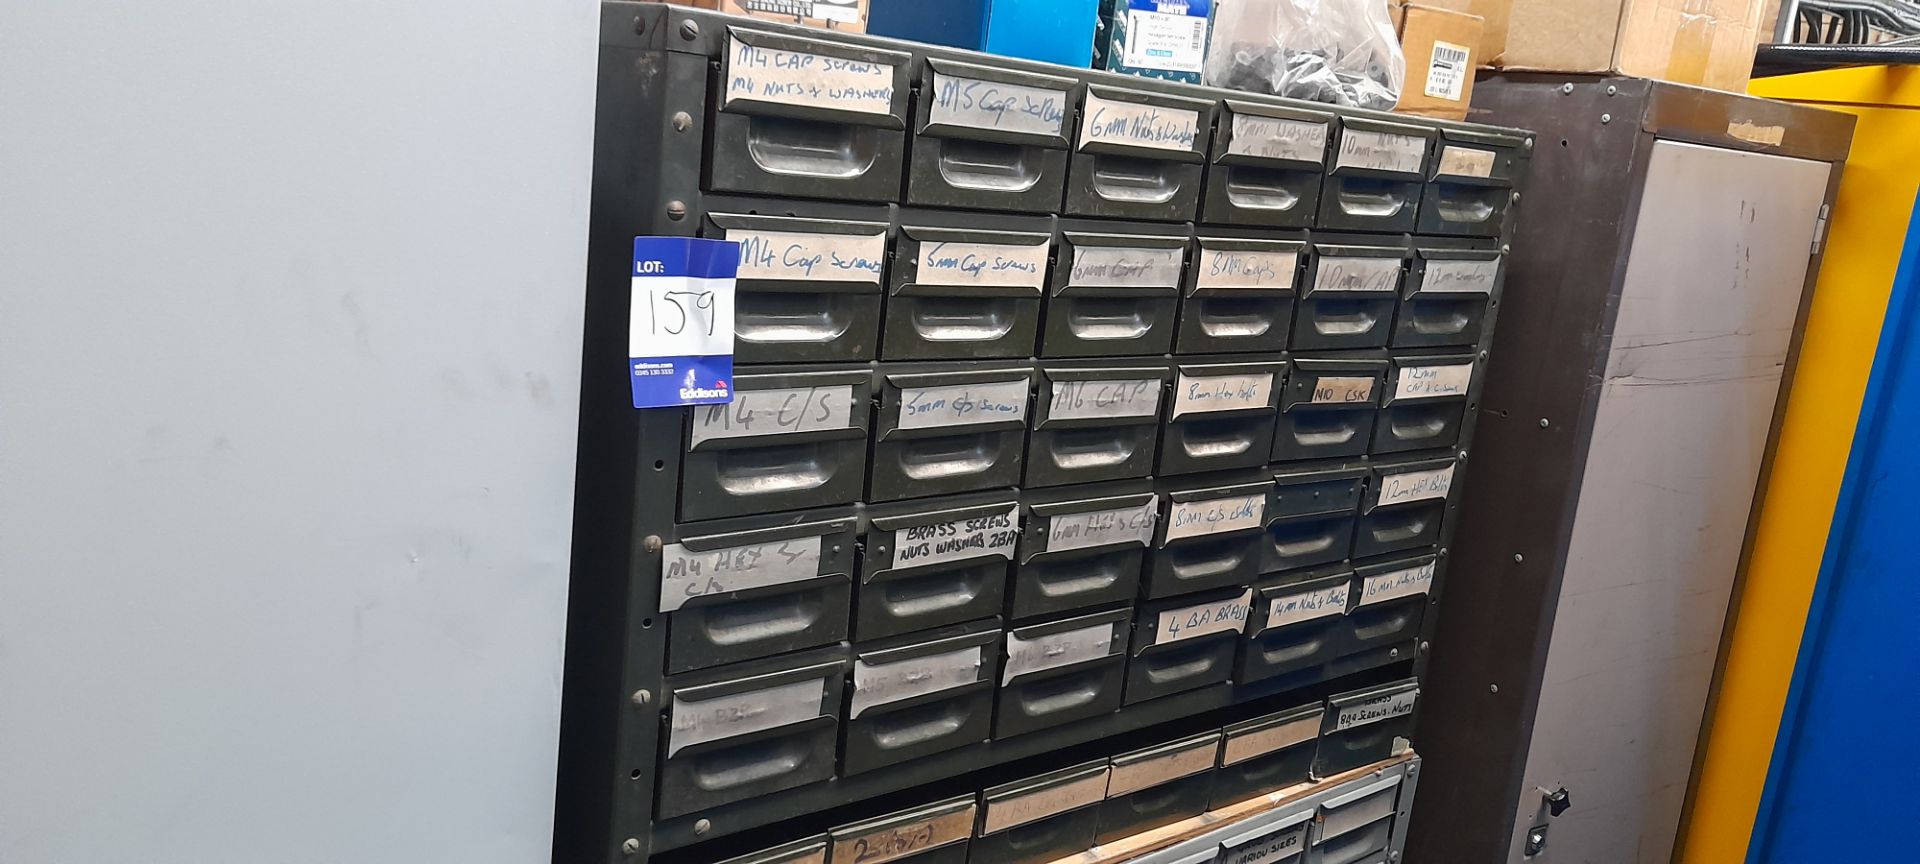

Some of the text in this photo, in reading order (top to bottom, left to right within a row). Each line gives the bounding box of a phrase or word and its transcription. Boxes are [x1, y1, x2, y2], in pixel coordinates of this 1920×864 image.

[738, 45, 767, 68] M4
[732, 77, 754, 92] M4
[740, 236, 776, 268] M4
[636, 261, 665, 274] LOT:
[649, 289, 715, 337] 159
[679, 387, 729, 400] Eddisons
[704, 395, 754, 431] M4
[906, 521, 957, 541] BRASS
[900, 542, 930, 561] NUTS
[1168, 603, 1248, 639] 4 BA BRASS
